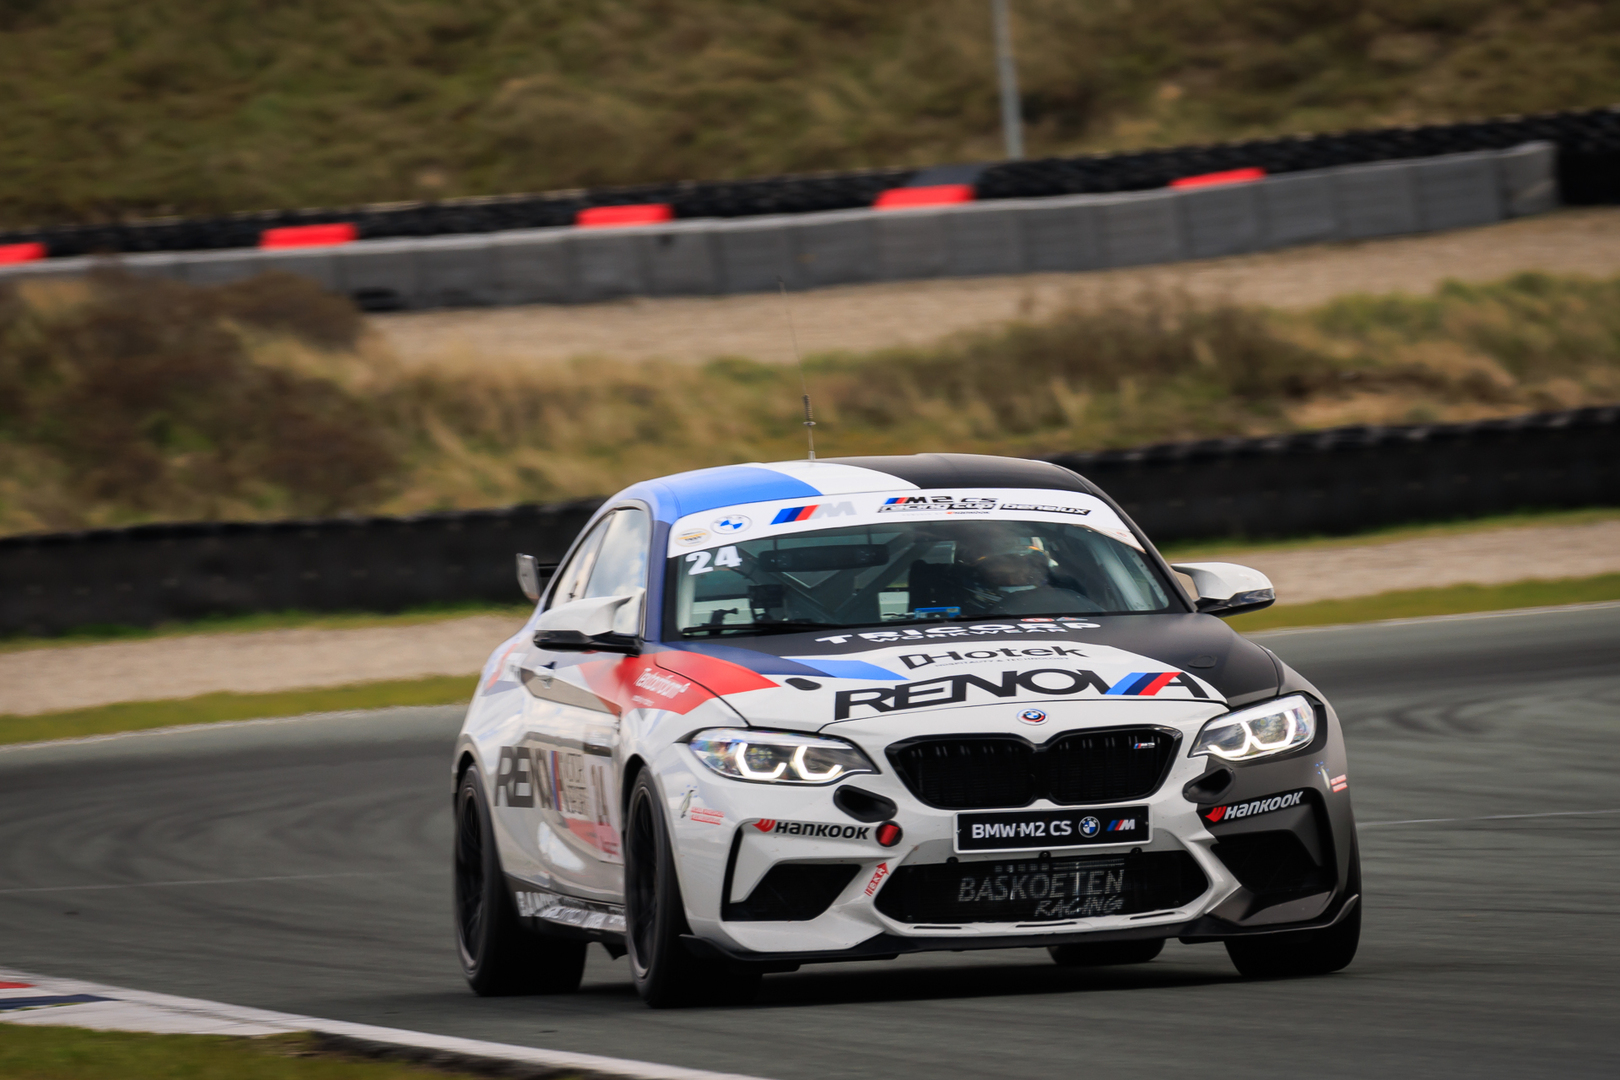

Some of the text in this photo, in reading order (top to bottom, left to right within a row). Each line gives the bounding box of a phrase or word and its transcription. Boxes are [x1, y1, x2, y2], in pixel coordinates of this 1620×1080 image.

[685, 545, 743, 576] 24
[815, 622, 1101, 645] TRICORP
[870, 628, 1068, 643] WORKWEAR
[834, 668, 1210, 721] RENOVA
[971, 822, 1017, 840] BMW
[1019, 821, 1046, 837] M2
[1049, 819, 1073, 837] CS
[958, 869, 1125, 902] BASKOETEN
[1033, 895, 1125, 918] RACING
